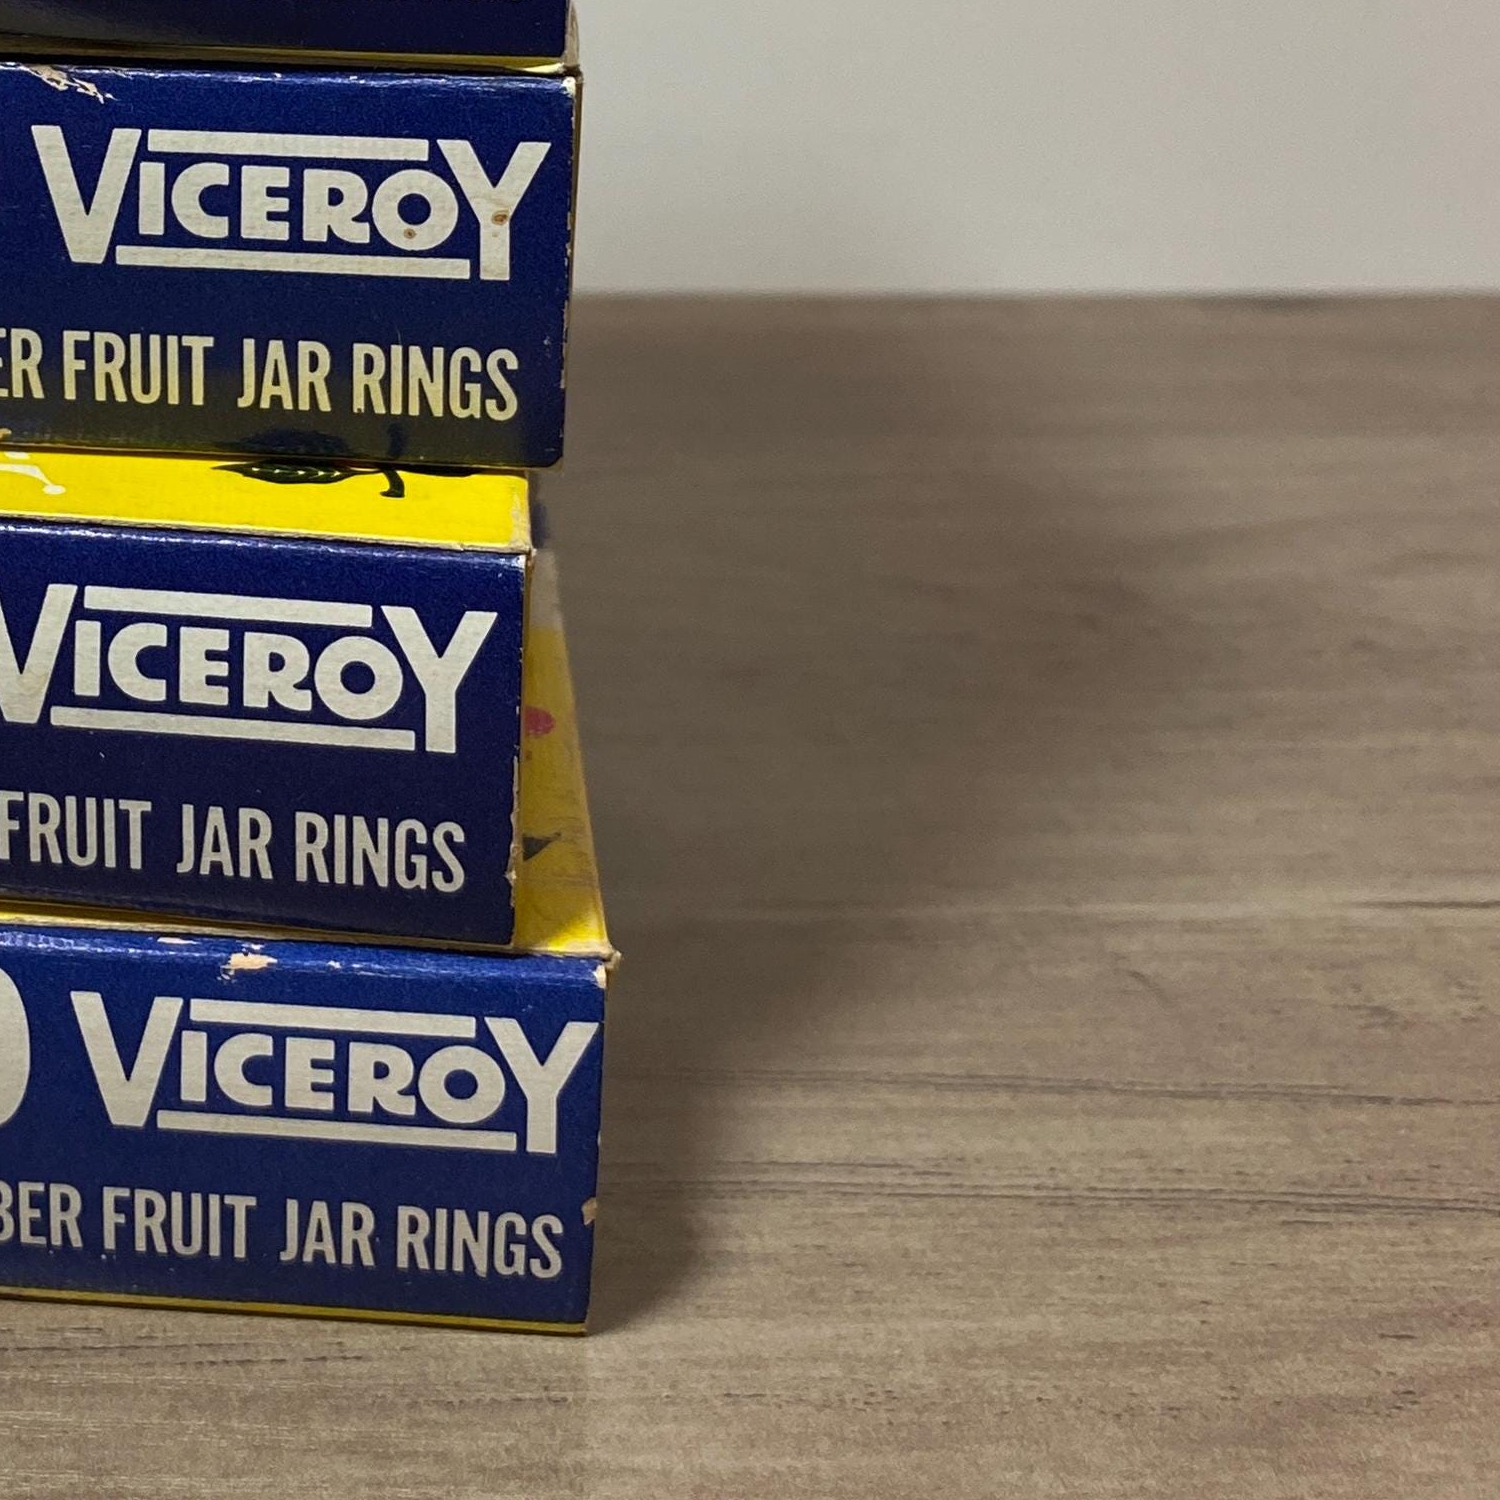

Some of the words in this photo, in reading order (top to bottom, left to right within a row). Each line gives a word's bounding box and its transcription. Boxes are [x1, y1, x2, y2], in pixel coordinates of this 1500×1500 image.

[31, 123, 550, 281] VICEROY
[62, 329, 213, 408] FRUIT
[236, 339, 331, 413] JAR
[352, 344, 520, 422] RINGS
[176, 803, 273, 880] JAR
[294, 811, 466, 893] RINGS
[70, 990, 599, 1154] VICEROY
[101, 1186, 257, 1260] FRUIT
[279, 1196, 376, 1268] JAR
[396, 1205, 563, 1279] RINGS
